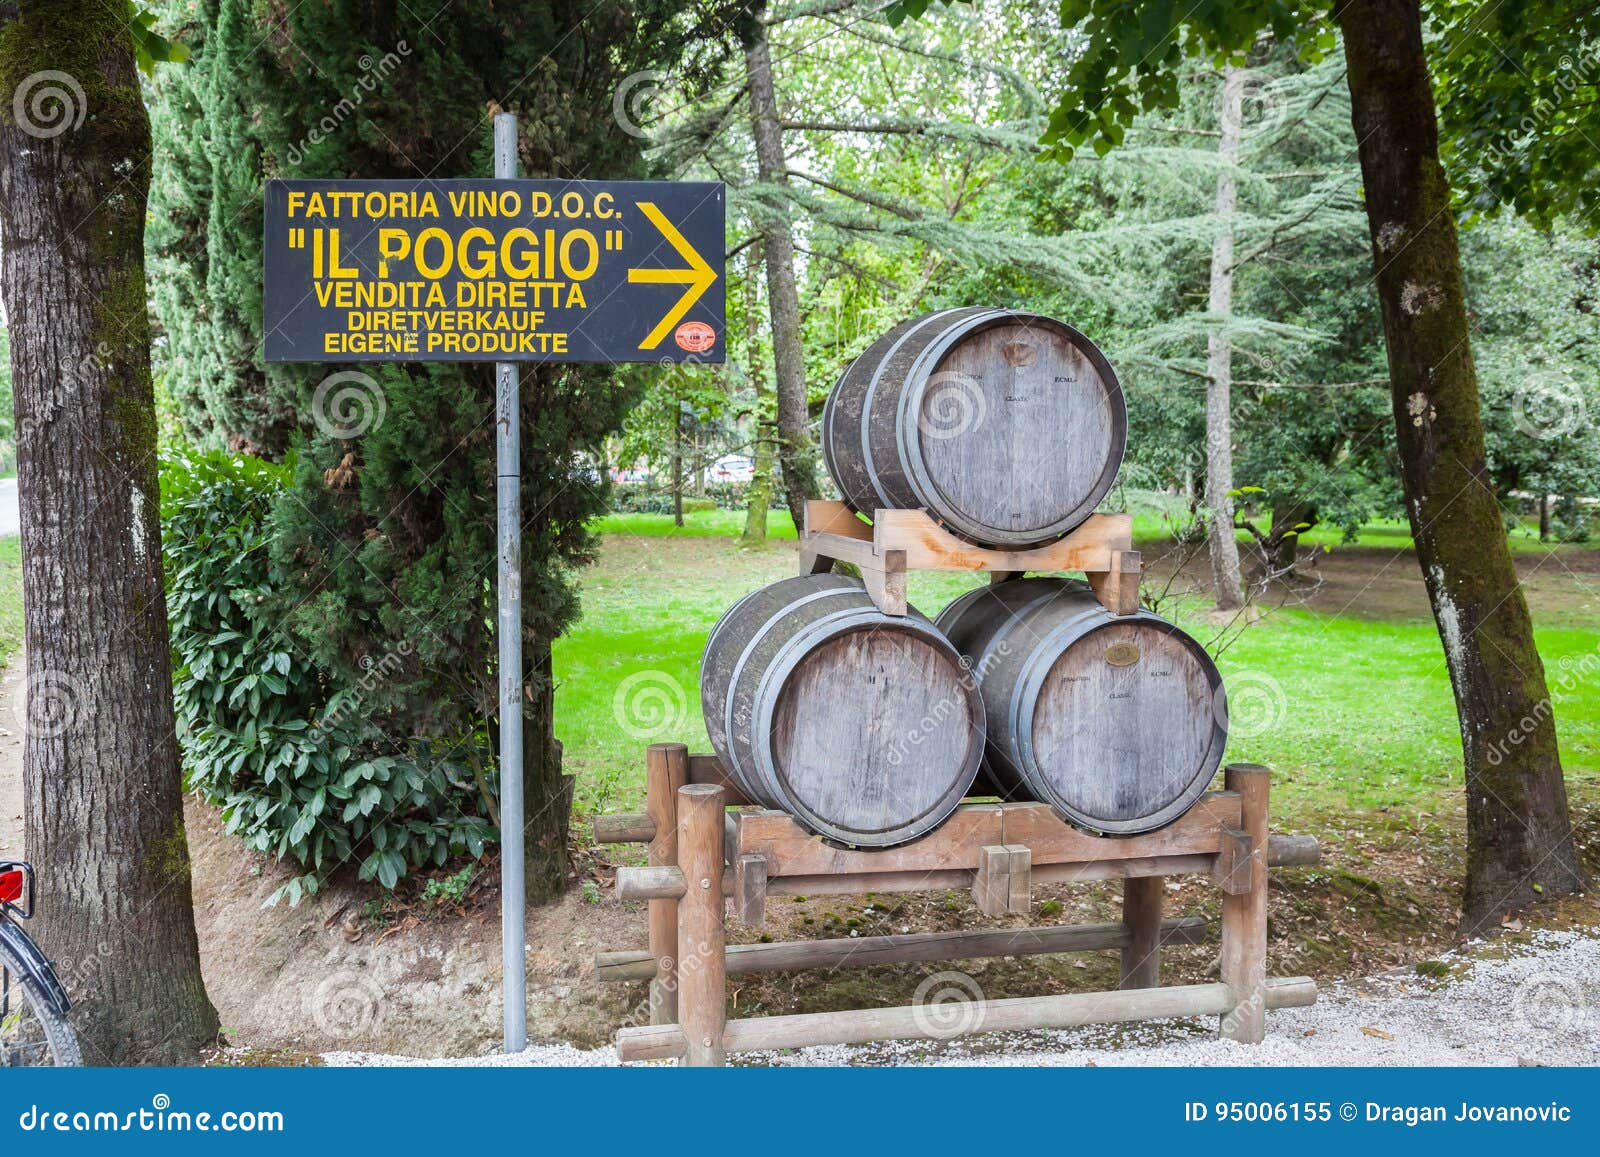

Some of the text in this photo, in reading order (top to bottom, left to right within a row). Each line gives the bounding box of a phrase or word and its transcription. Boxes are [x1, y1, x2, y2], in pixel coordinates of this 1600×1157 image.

[287, 190, 623, 219] FATTORIA VINO D.O.C.
[378, 226, 623, 281] POGGIO"
[314, 281, 588, 309] VENDITA DIRETTA
[348, 311, 545, 331] DIRETVERKAUF
[324, 333, 568, 354] EIGENE PRODUKTE
